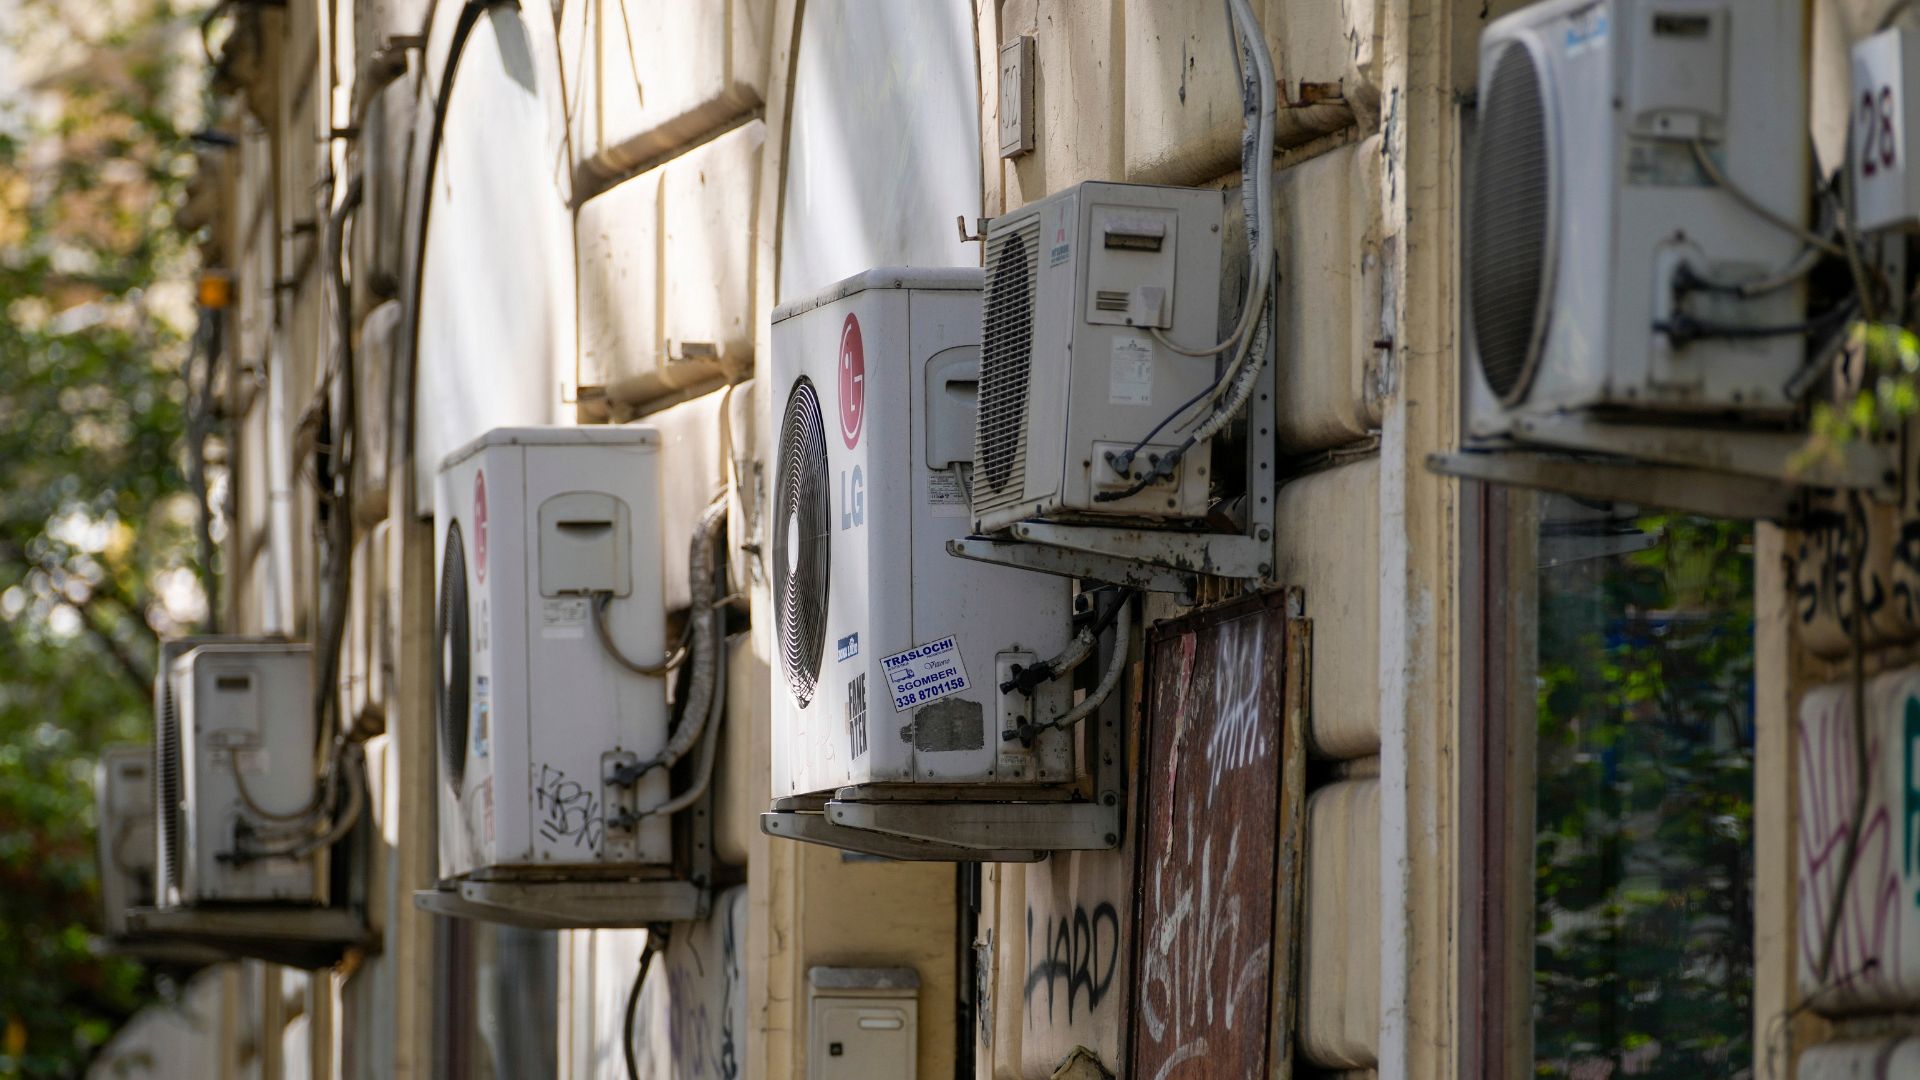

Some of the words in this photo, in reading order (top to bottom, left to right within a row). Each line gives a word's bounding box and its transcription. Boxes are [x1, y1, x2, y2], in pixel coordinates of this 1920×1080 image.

[1860, 85, 1896, 178] 28
[841, 464, 864, 530] LG
[883, 638, 954, 668] TRASLOCHI
[896, 693, 917, 708] 338
[918, 677, 965, 701] 8701158
[897, 667, 957, 693] SGOMBERI
